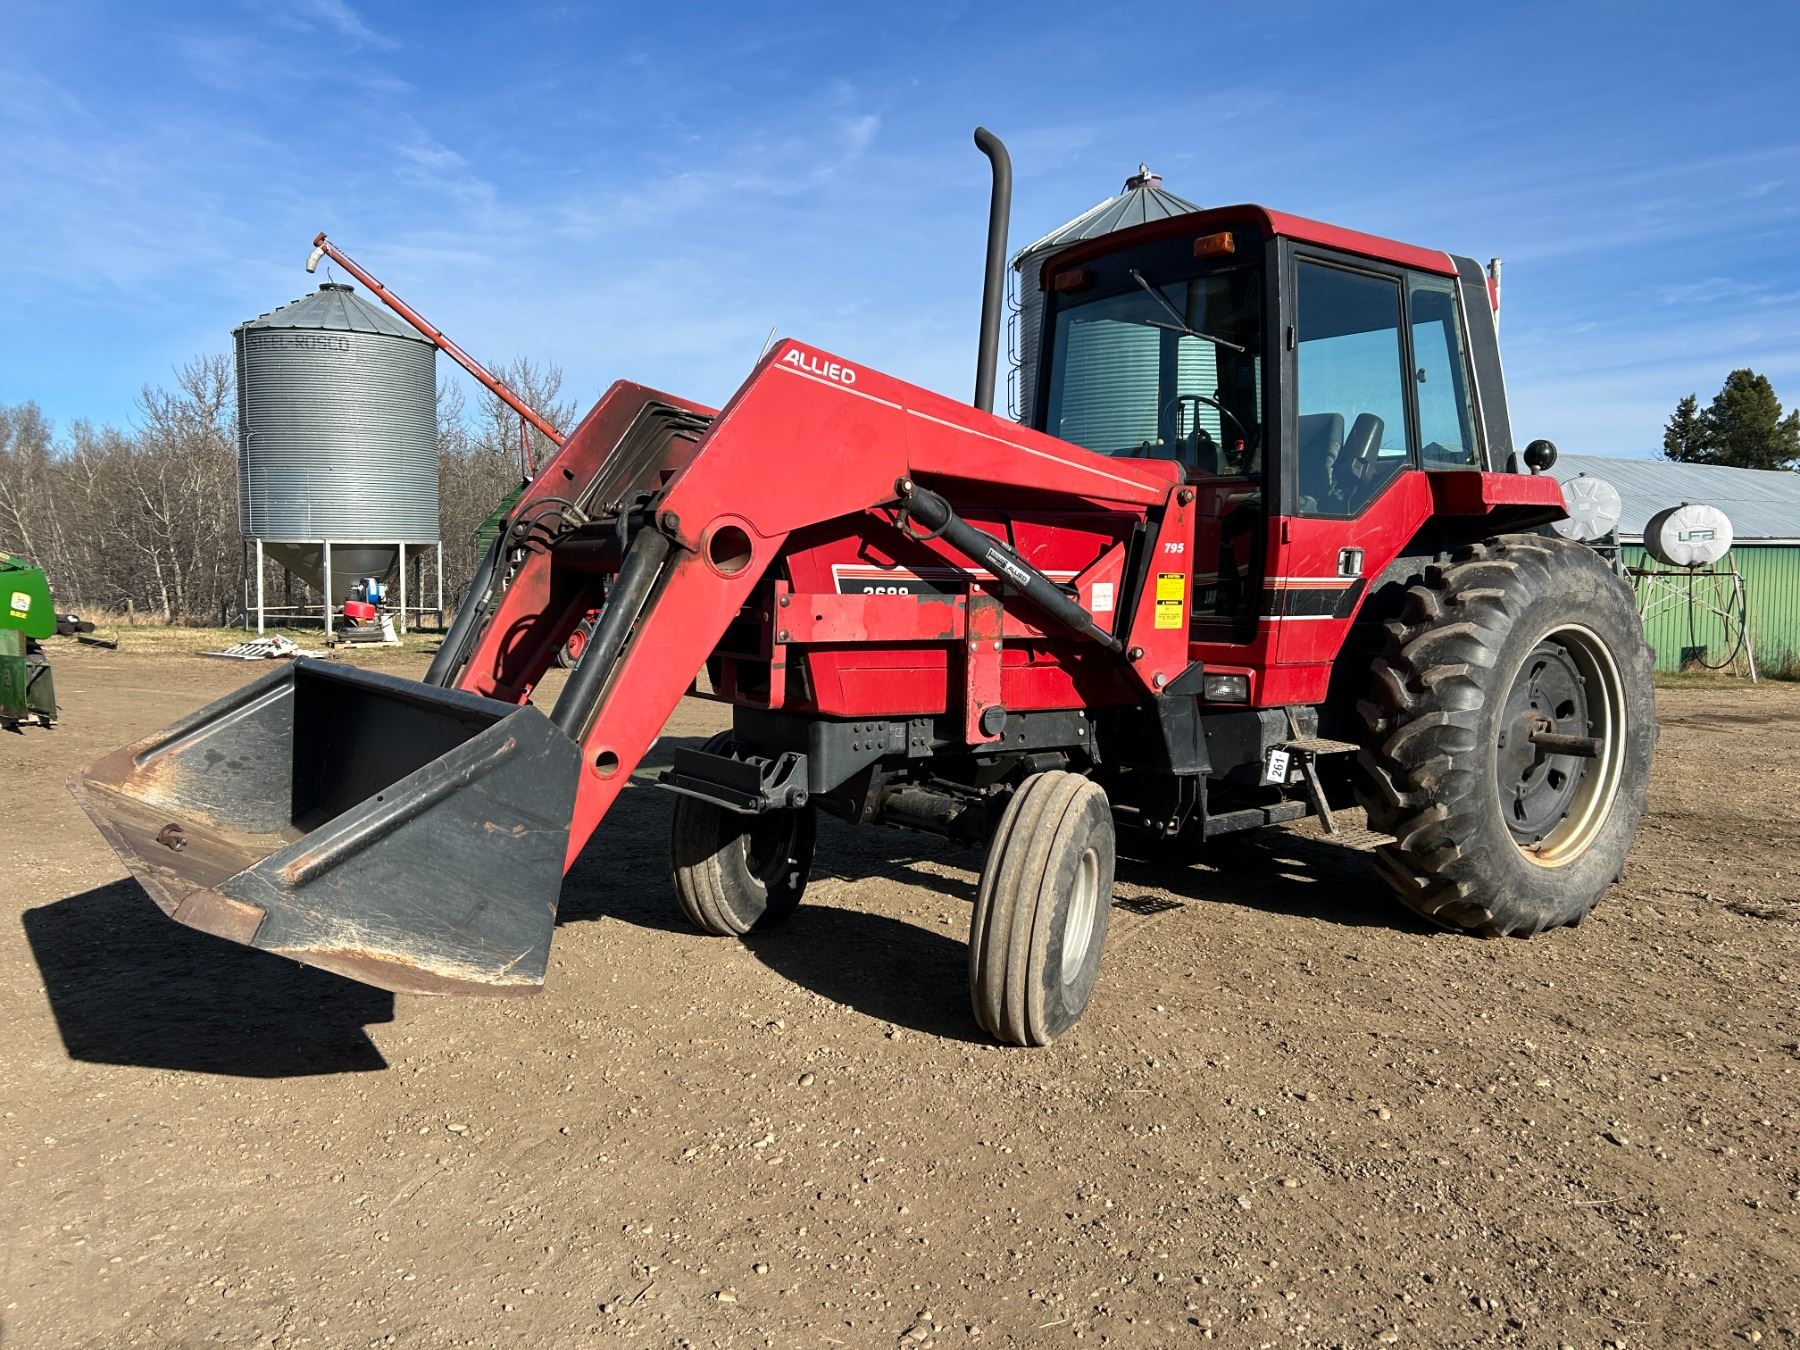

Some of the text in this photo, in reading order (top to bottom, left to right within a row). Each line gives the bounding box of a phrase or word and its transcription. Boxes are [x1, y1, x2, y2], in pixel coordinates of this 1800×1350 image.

[782, 348, 856, 384] ALLIED
[1164, 542, 1185, 554] 795
[1007, 566, 1027, 582] ALLIED
[1272, 758, 1285, 778] 261
